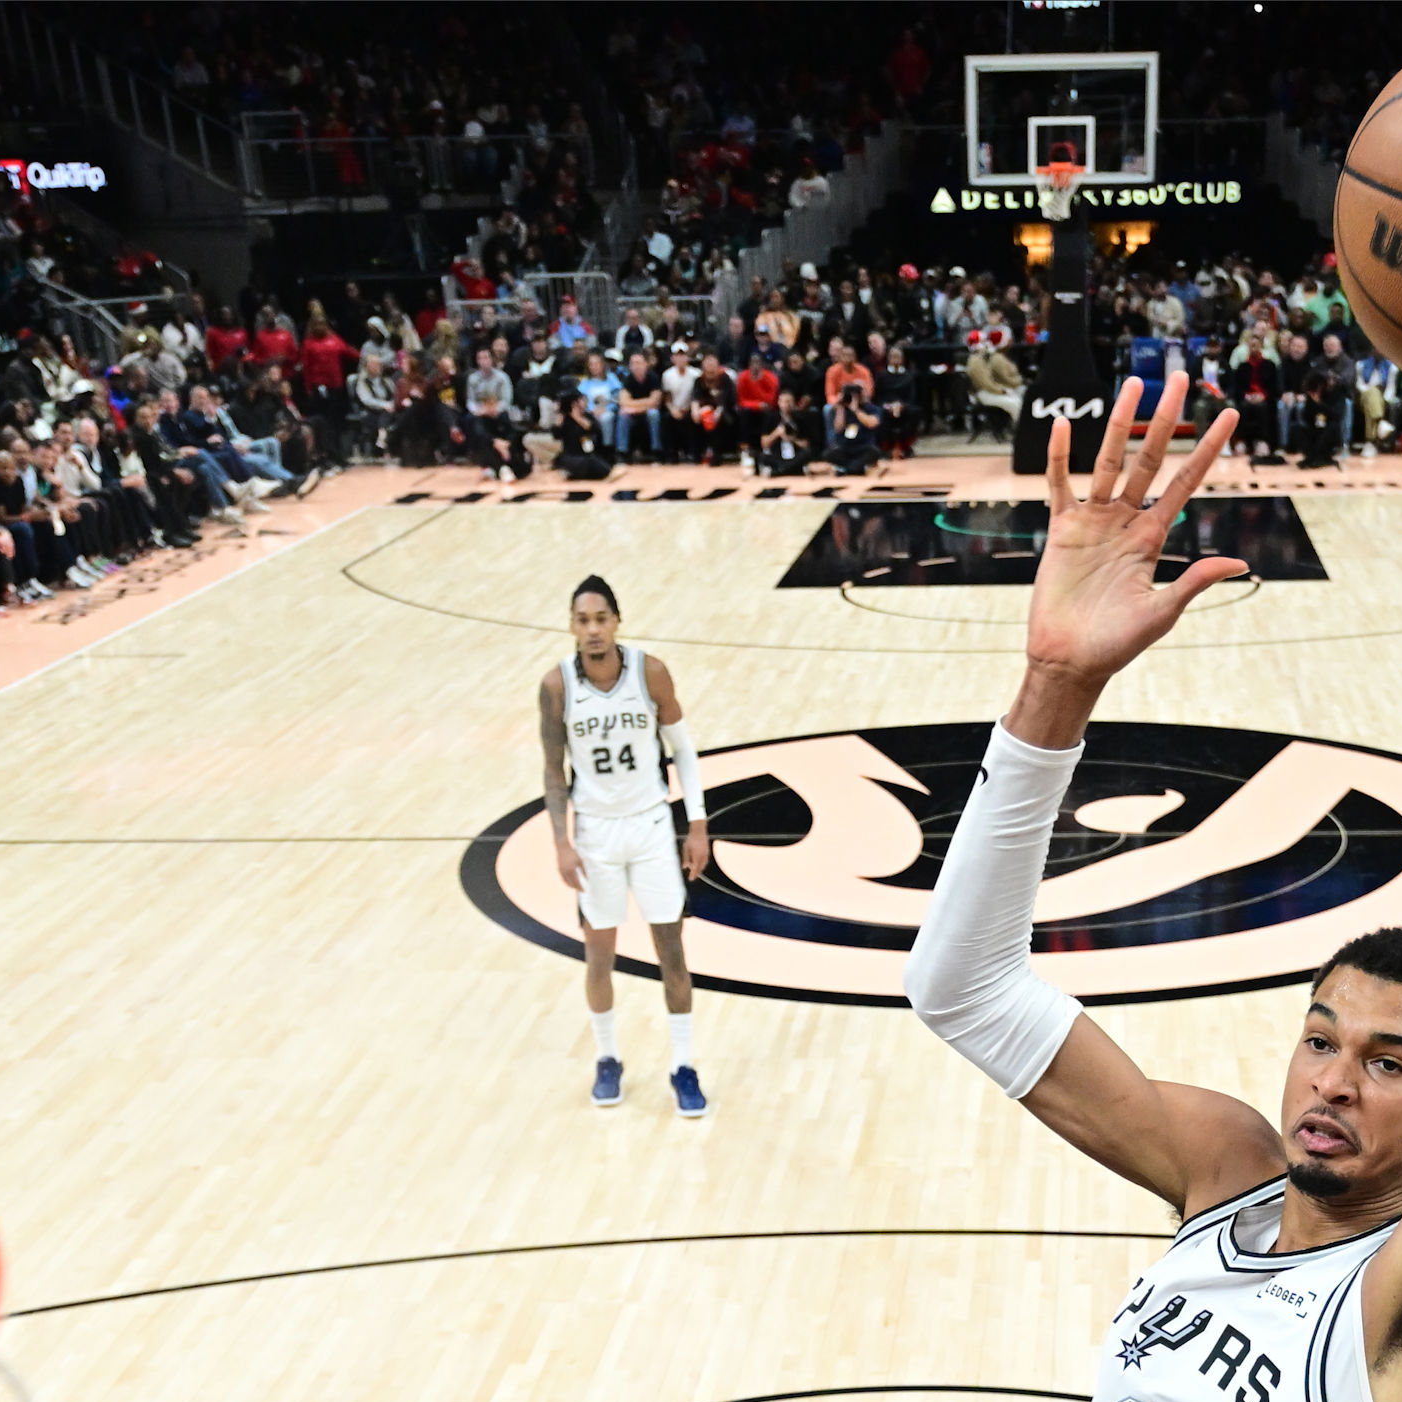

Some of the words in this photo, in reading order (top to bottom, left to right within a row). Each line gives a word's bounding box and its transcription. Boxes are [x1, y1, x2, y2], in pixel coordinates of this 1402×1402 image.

[573, 712, 648, 739] SPURS
[592, 744, 637, 774] 24
[1265, 1281, 1305, 1308] LEDGER
